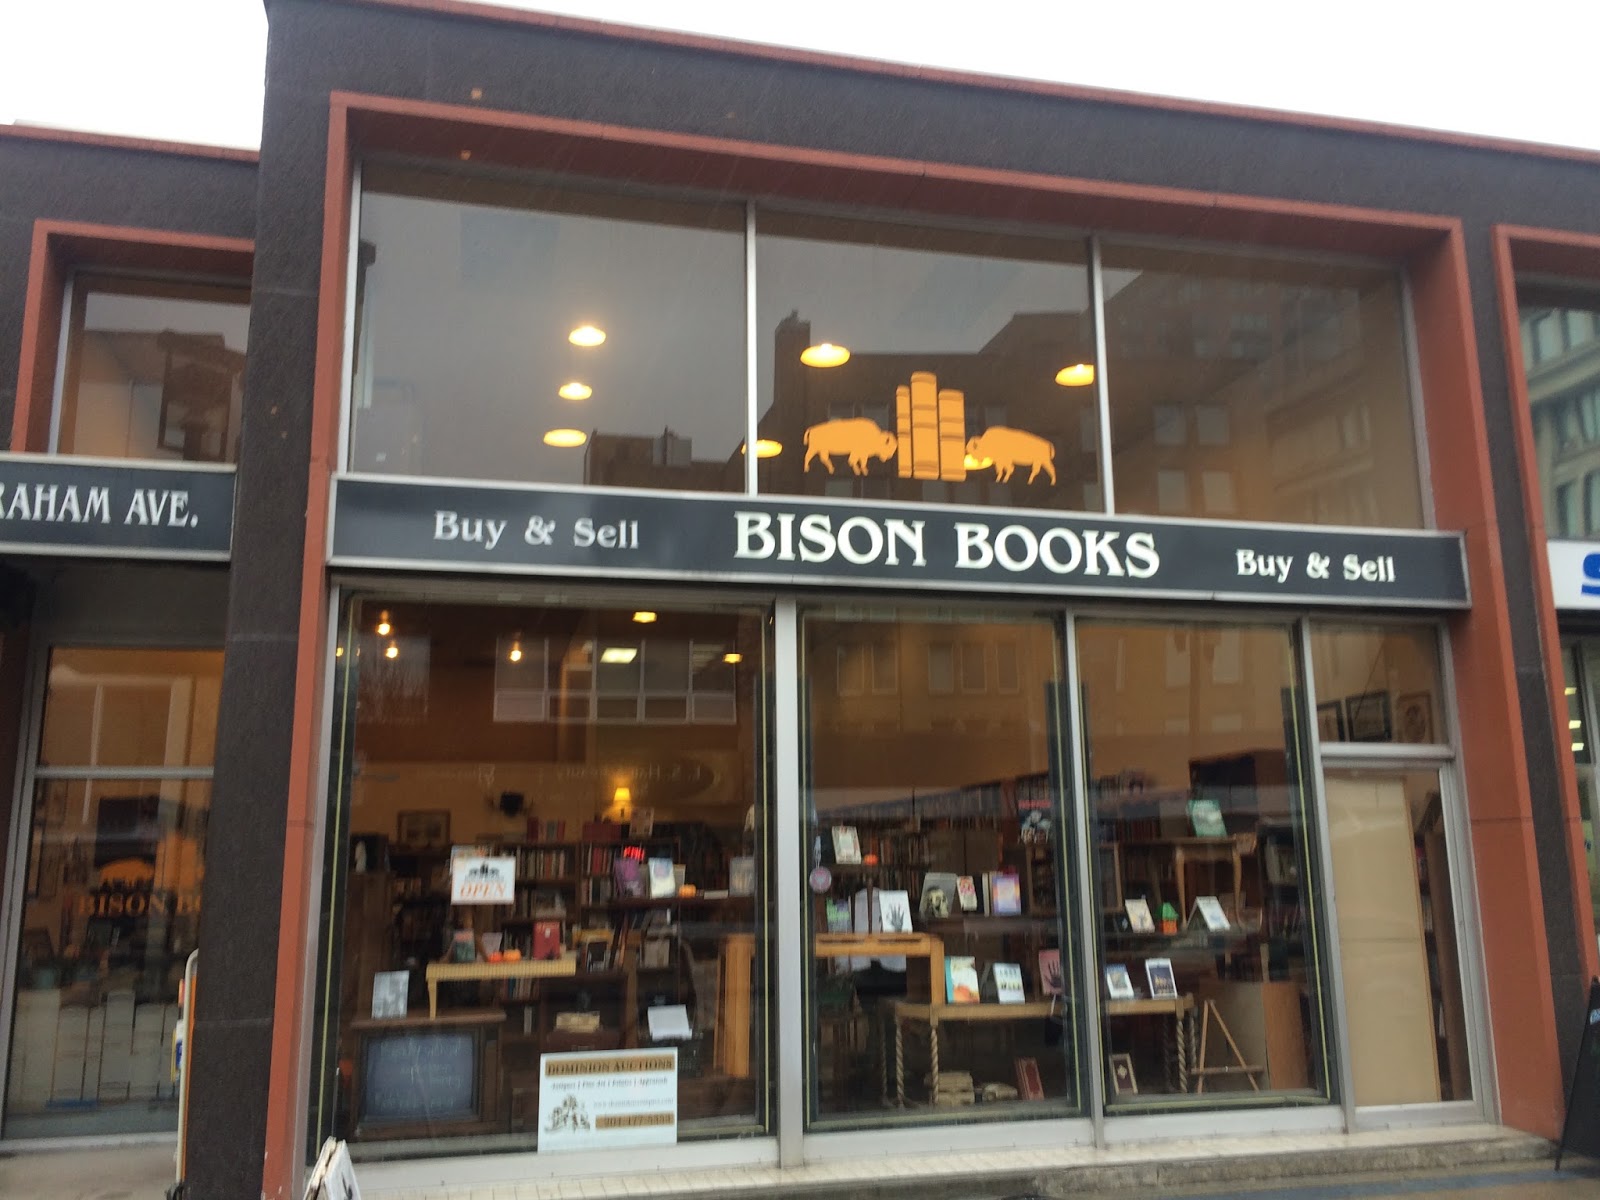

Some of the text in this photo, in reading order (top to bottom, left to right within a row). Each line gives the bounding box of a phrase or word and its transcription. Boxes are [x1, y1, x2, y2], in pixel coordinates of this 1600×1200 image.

[0, 482, 199, 528] AHAM AVE.
[433, 510, 639, 550] Buy & Sell
[733, 510, 1161, 579] BISON BOOKS
[1236, 548, 1396, 584] Buy & Sell
[460, 882, 504, 897] OPEN
[548, 1059, 672, 1075] DOMINION AUCTIONS
